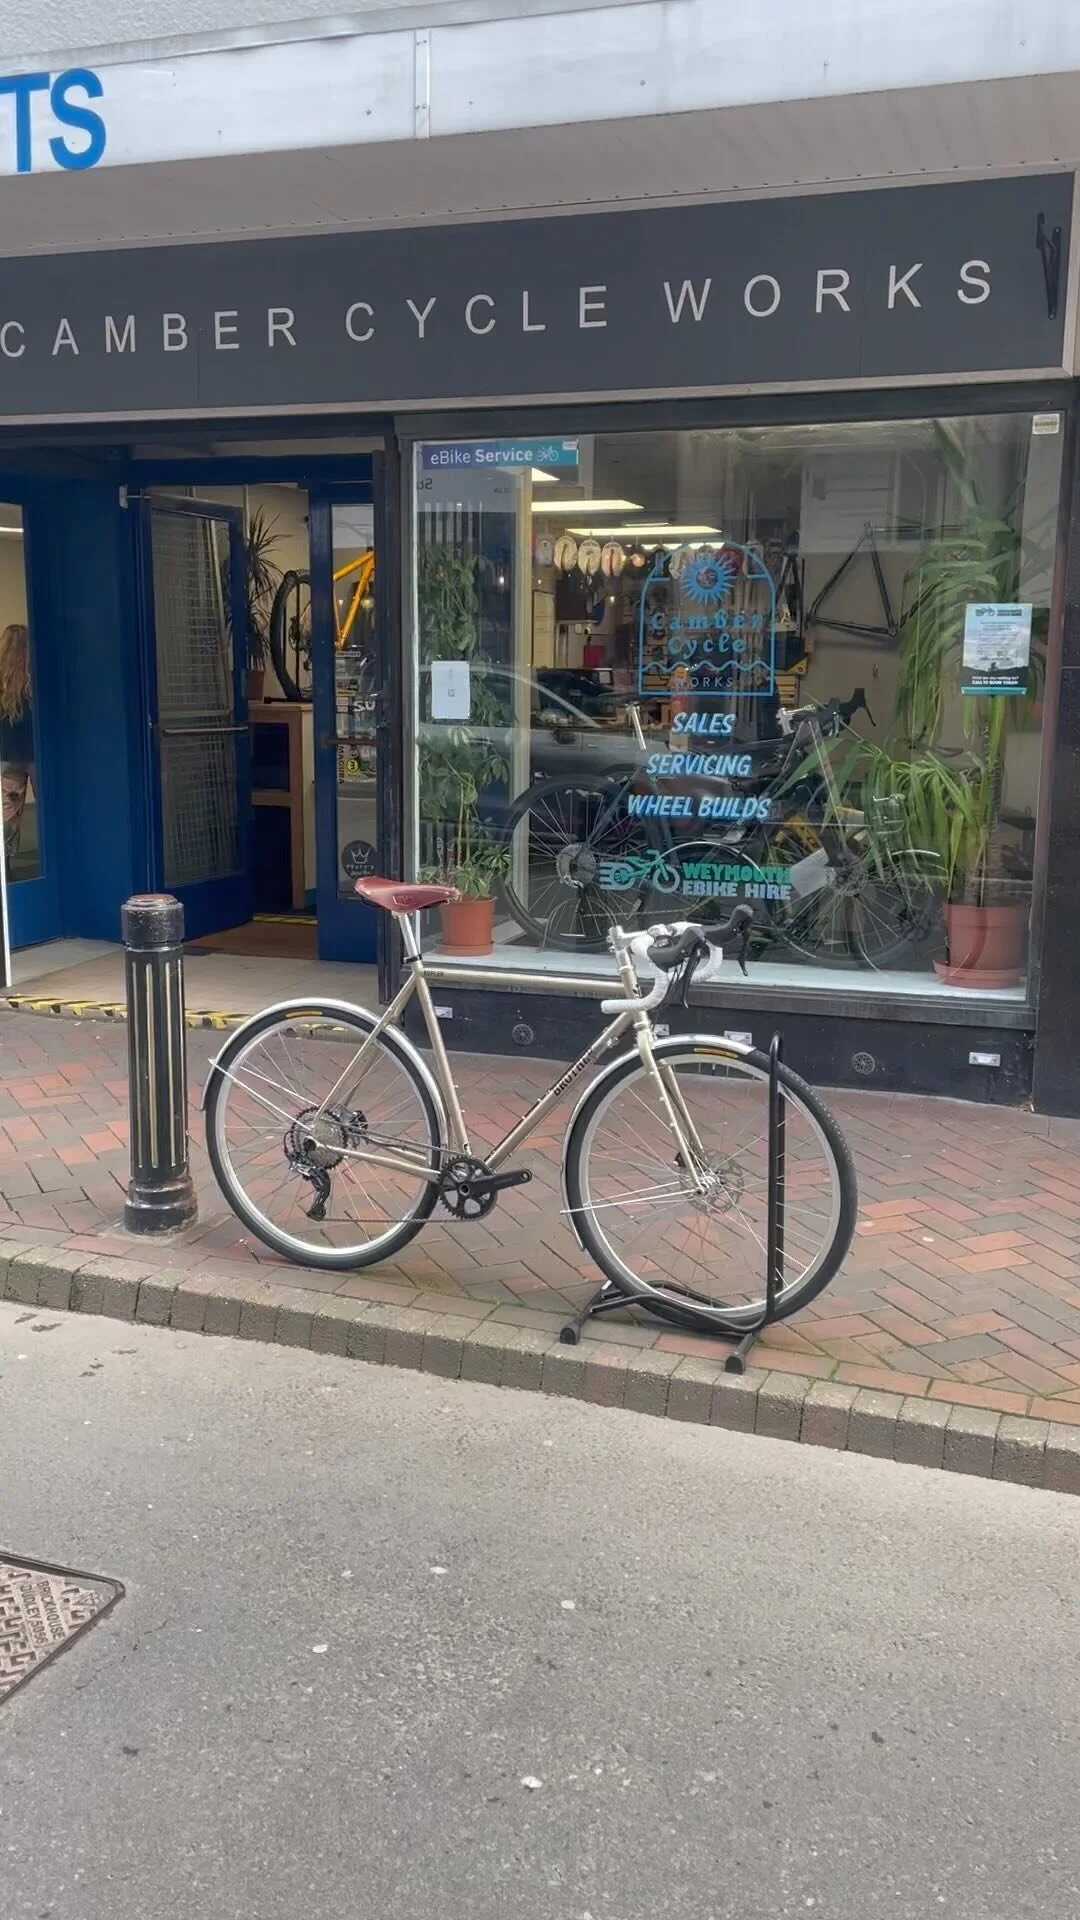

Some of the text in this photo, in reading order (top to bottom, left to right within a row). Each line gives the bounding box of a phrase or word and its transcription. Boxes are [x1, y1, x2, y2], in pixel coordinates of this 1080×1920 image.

[0, 68, 106, 173] TS
[0, 259, 992, 358] CAMBER CYCLE WORKS
[430, 447, 533, 465] eBike Service
[651, 608, 763, 630] Camber
[668, 632, 746, 660] Cycle
[675, 676, 733, 688] WORKS
[672, 712, 736, 734] SALES
[646, 753, 752, 776] SERVICING
[628, 794, 772, 818] WHEEL BUILDS
[682, 862, 792, 884] WEYMOUTH
[683, 880, 791, 900] EBIKE HIRE
